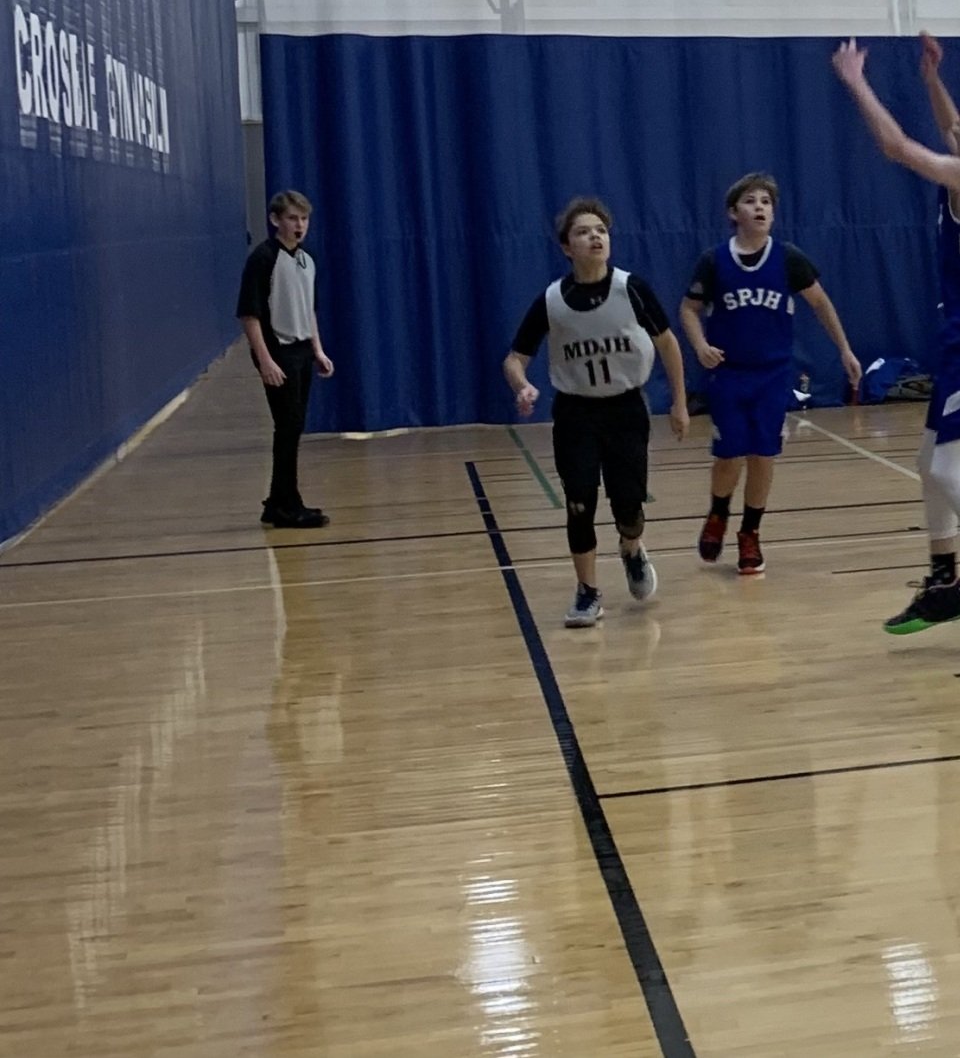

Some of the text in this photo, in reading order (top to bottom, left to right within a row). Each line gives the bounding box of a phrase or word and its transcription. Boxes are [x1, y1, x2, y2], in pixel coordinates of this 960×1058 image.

[14, 4, 98, 131] CROSBIE
[723, 288, 782, 311] SPJH
[563, 336, 632, 360] MDJH
[585, 356, 611, 387] 11
